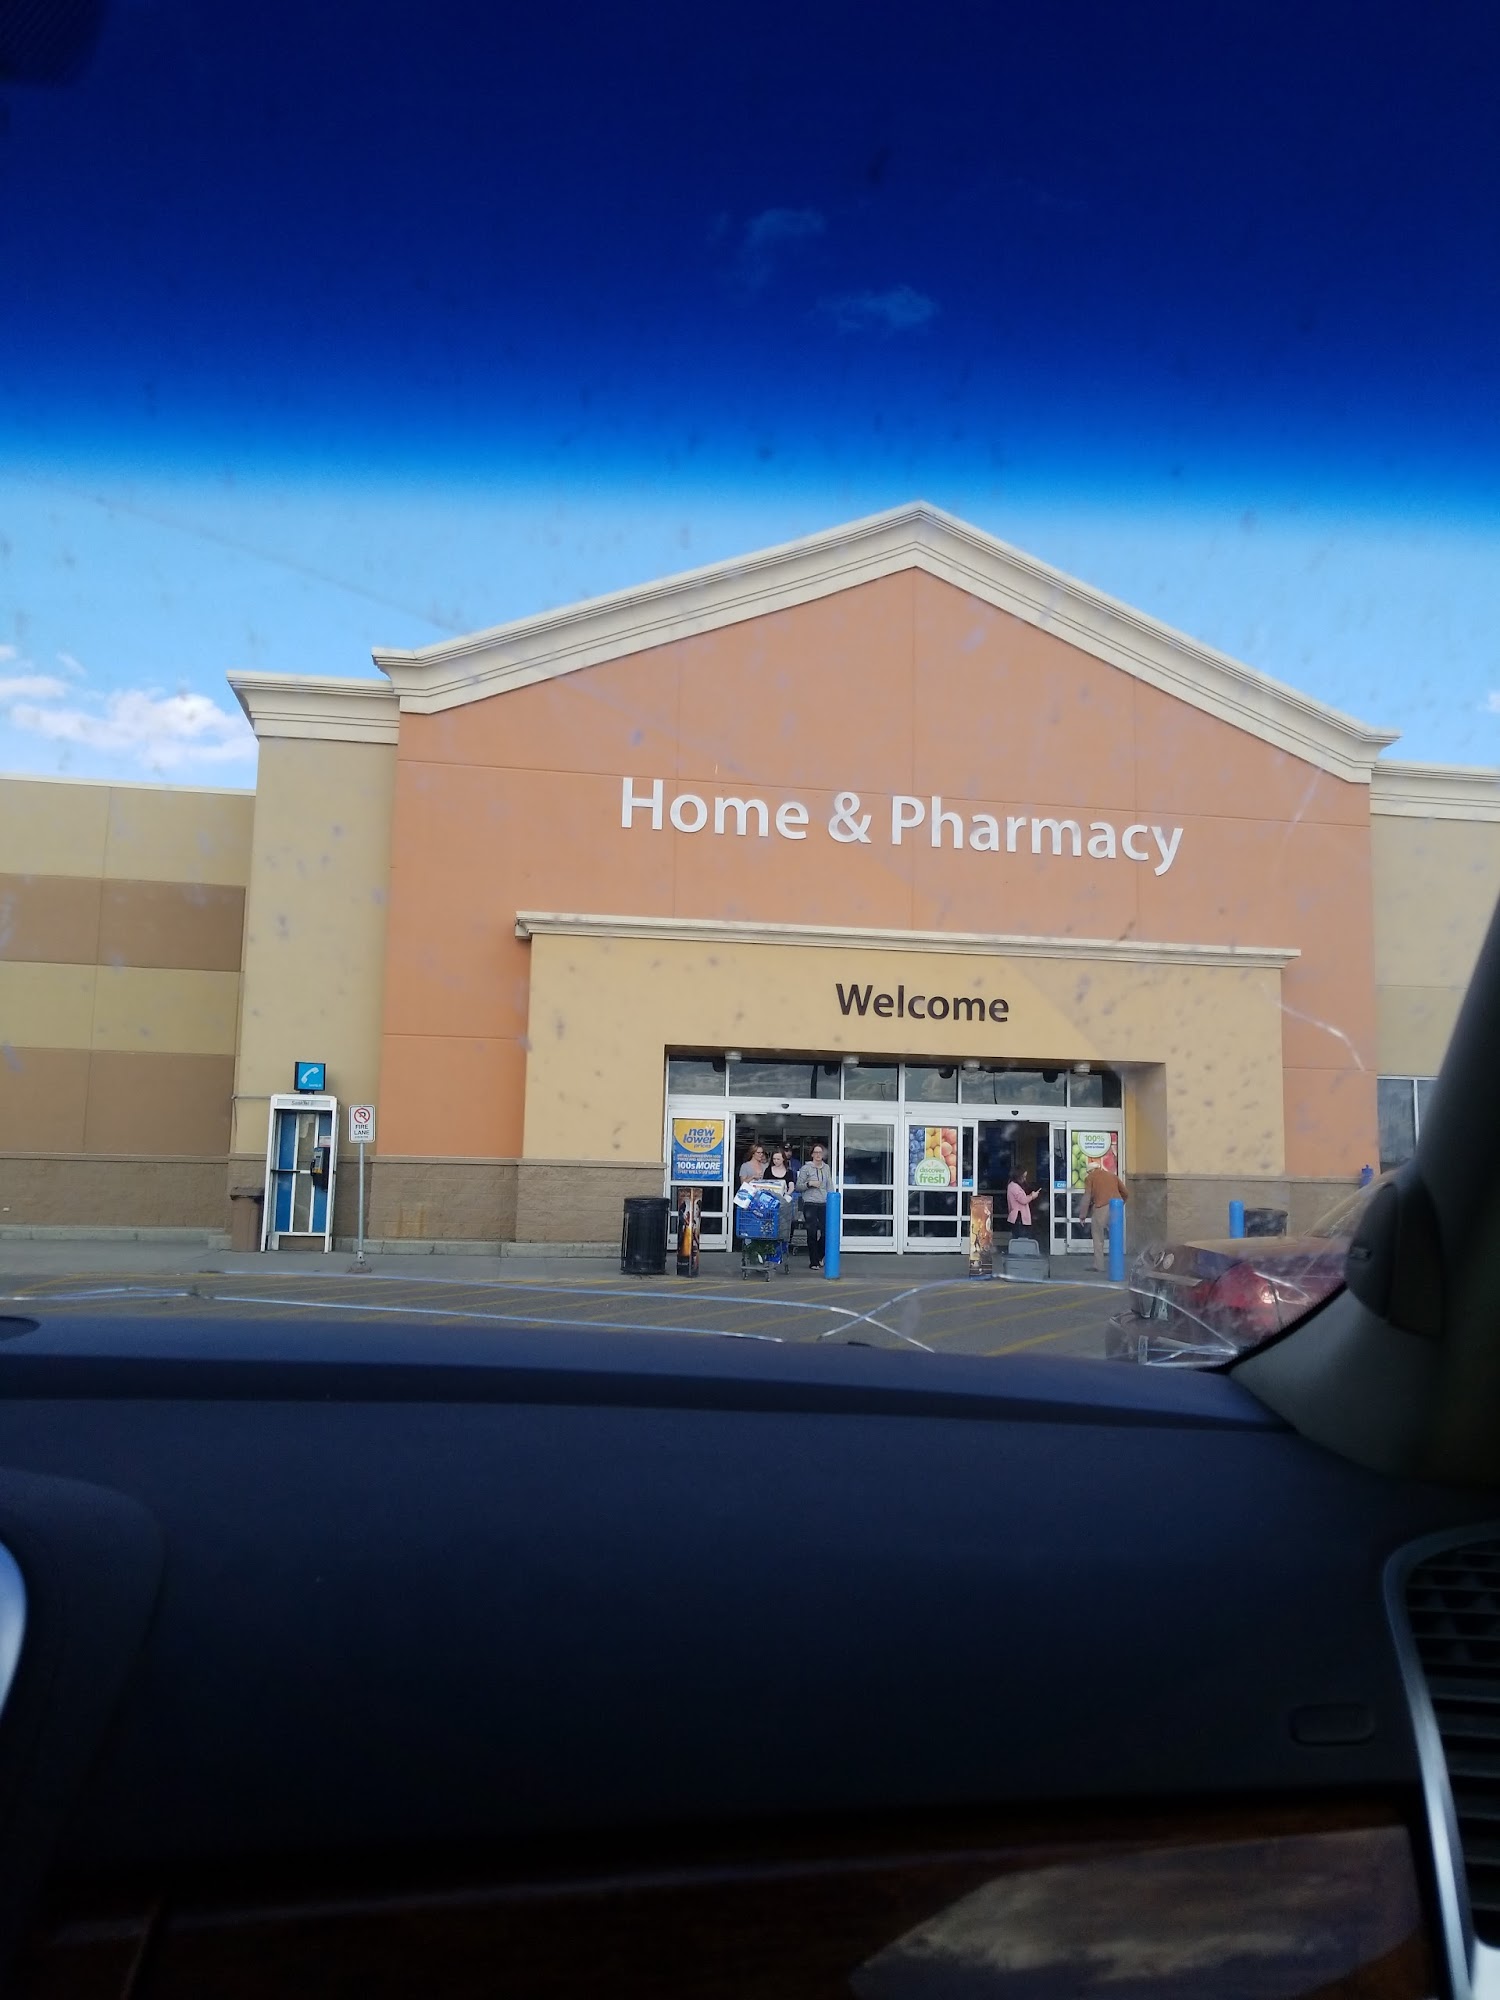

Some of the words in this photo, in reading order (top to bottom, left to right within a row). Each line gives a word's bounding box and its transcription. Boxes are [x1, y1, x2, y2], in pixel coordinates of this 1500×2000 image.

[621, 776, 810, 840] Home
[827, 791, 872, 845] &
[891, 795, 1185, 877] Pharmacy
[835, 983, 1010, 1023] Welcome
[689, 1128, 715, 1136] new
[683, 1134, 716, 1143] lower
[676, 1161, 695, 1170] 100s
[696, 1162, 721, 1170] MORE
[919, 1174, 946, 1184] fresh
